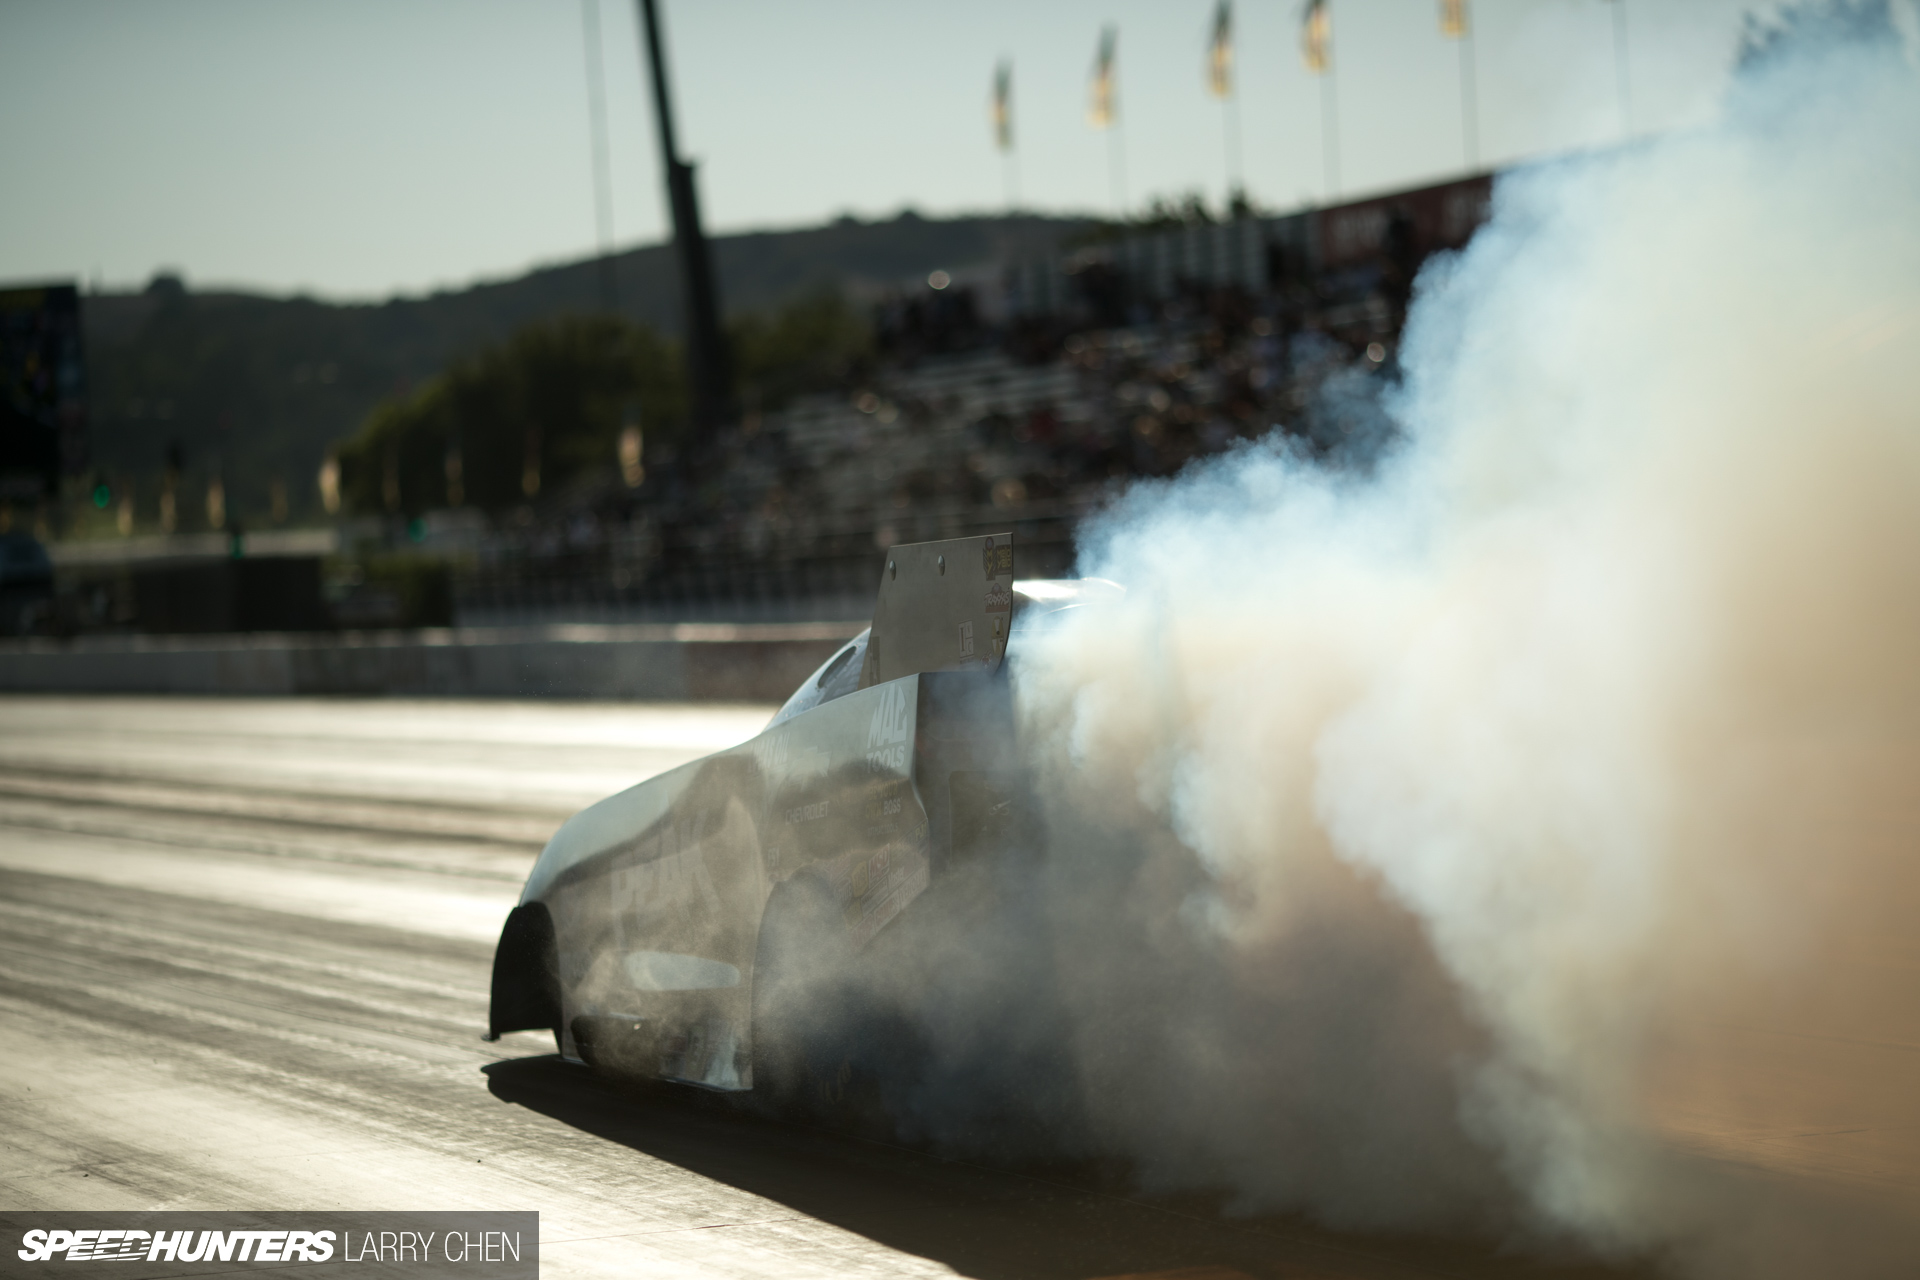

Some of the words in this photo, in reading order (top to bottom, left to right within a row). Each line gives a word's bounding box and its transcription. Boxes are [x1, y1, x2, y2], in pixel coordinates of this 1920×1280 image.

[867, 683, 907, 749] MAC
[866, 746, 905, 773] TOOLS
[785, 801, 829, 826] CHEVROLET
[884, 798, 901, 816] BOSS
[610, 807, 722, 950] PEAK
